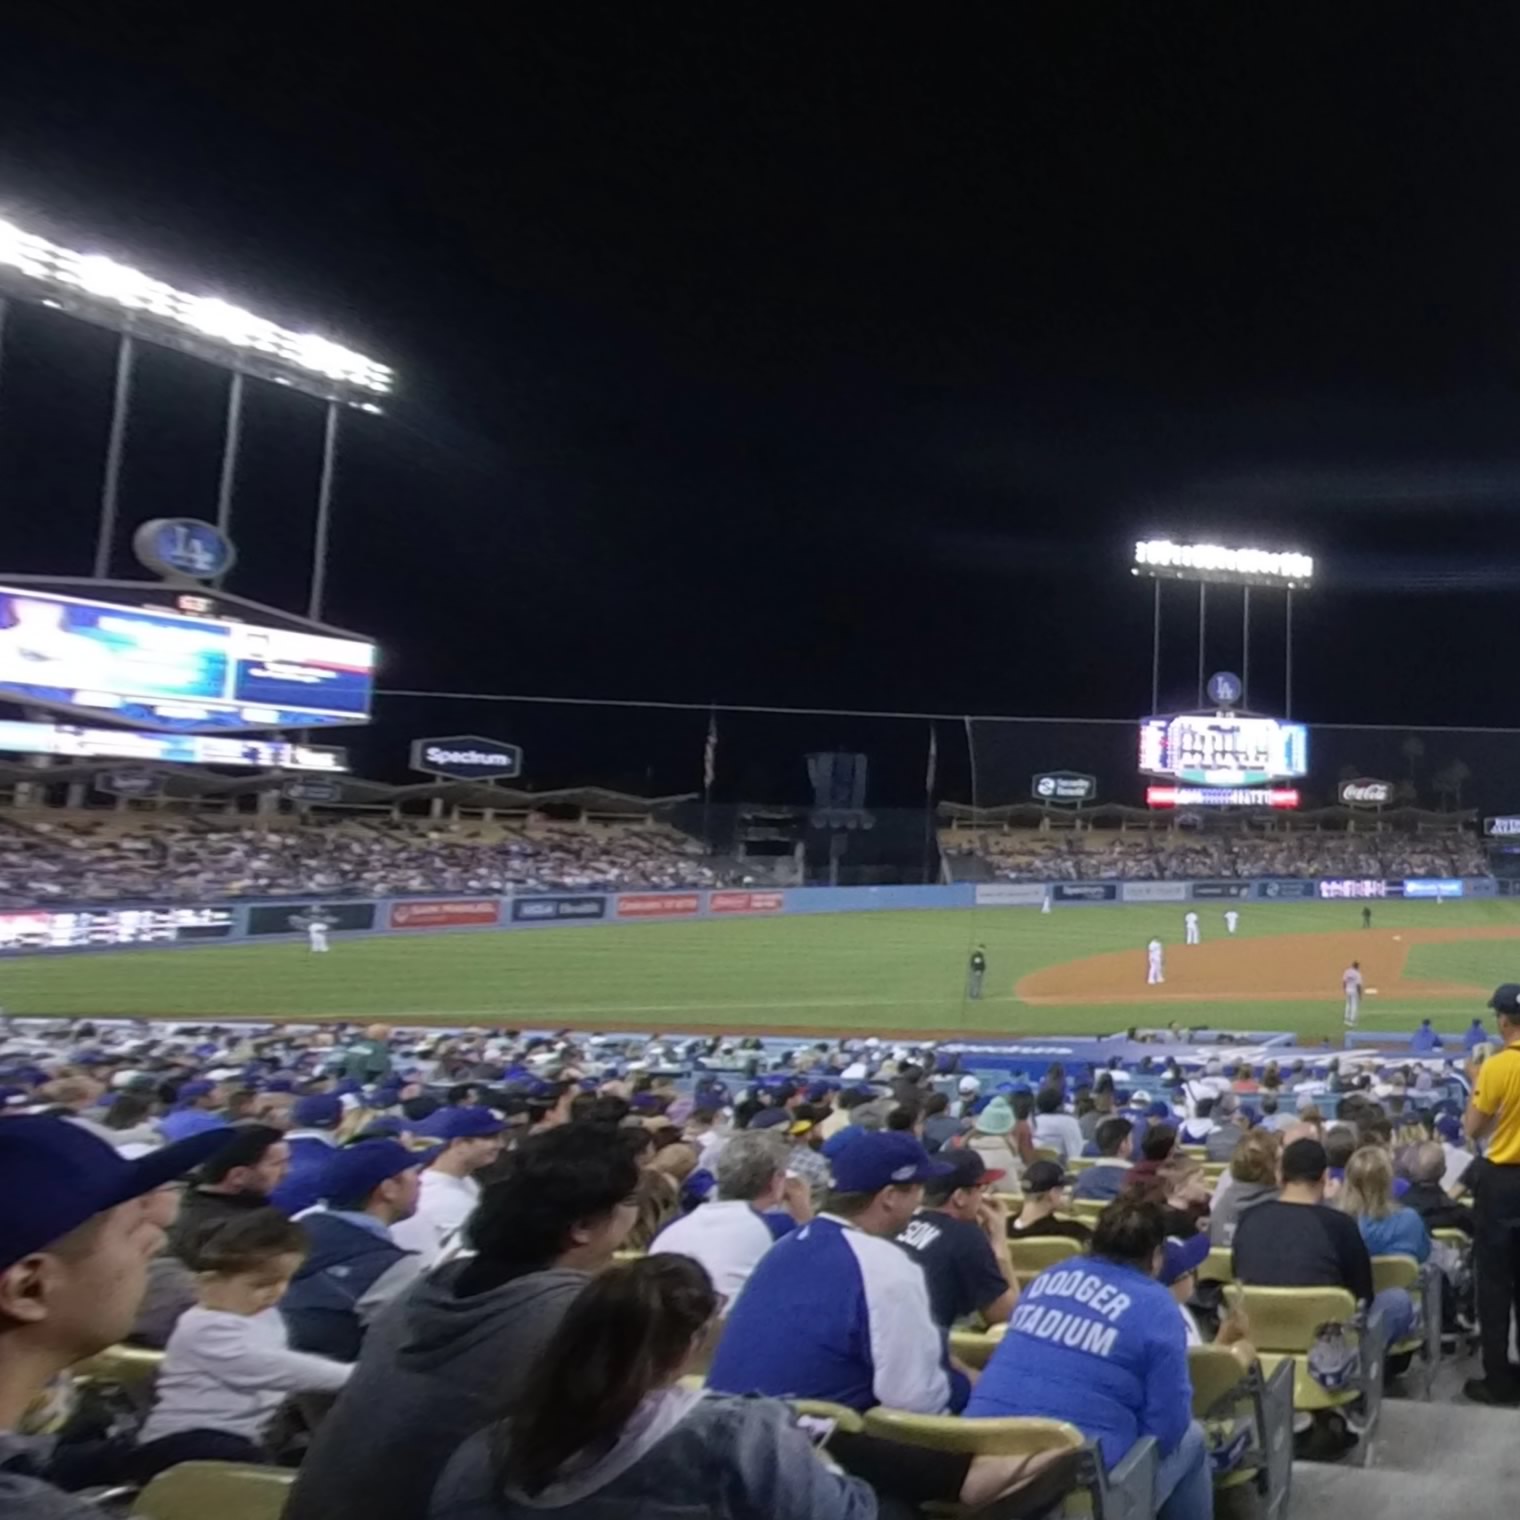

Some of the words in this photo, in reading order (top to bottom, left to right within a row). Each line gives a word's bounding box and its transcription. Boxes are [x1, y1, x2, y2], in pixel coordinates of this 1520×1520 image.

[426, 747, 512, 766] Spectrum
[1027, 1270, 1131, 1322] DODGER
[1010, 1304, 1118, 1358] STADIUM
